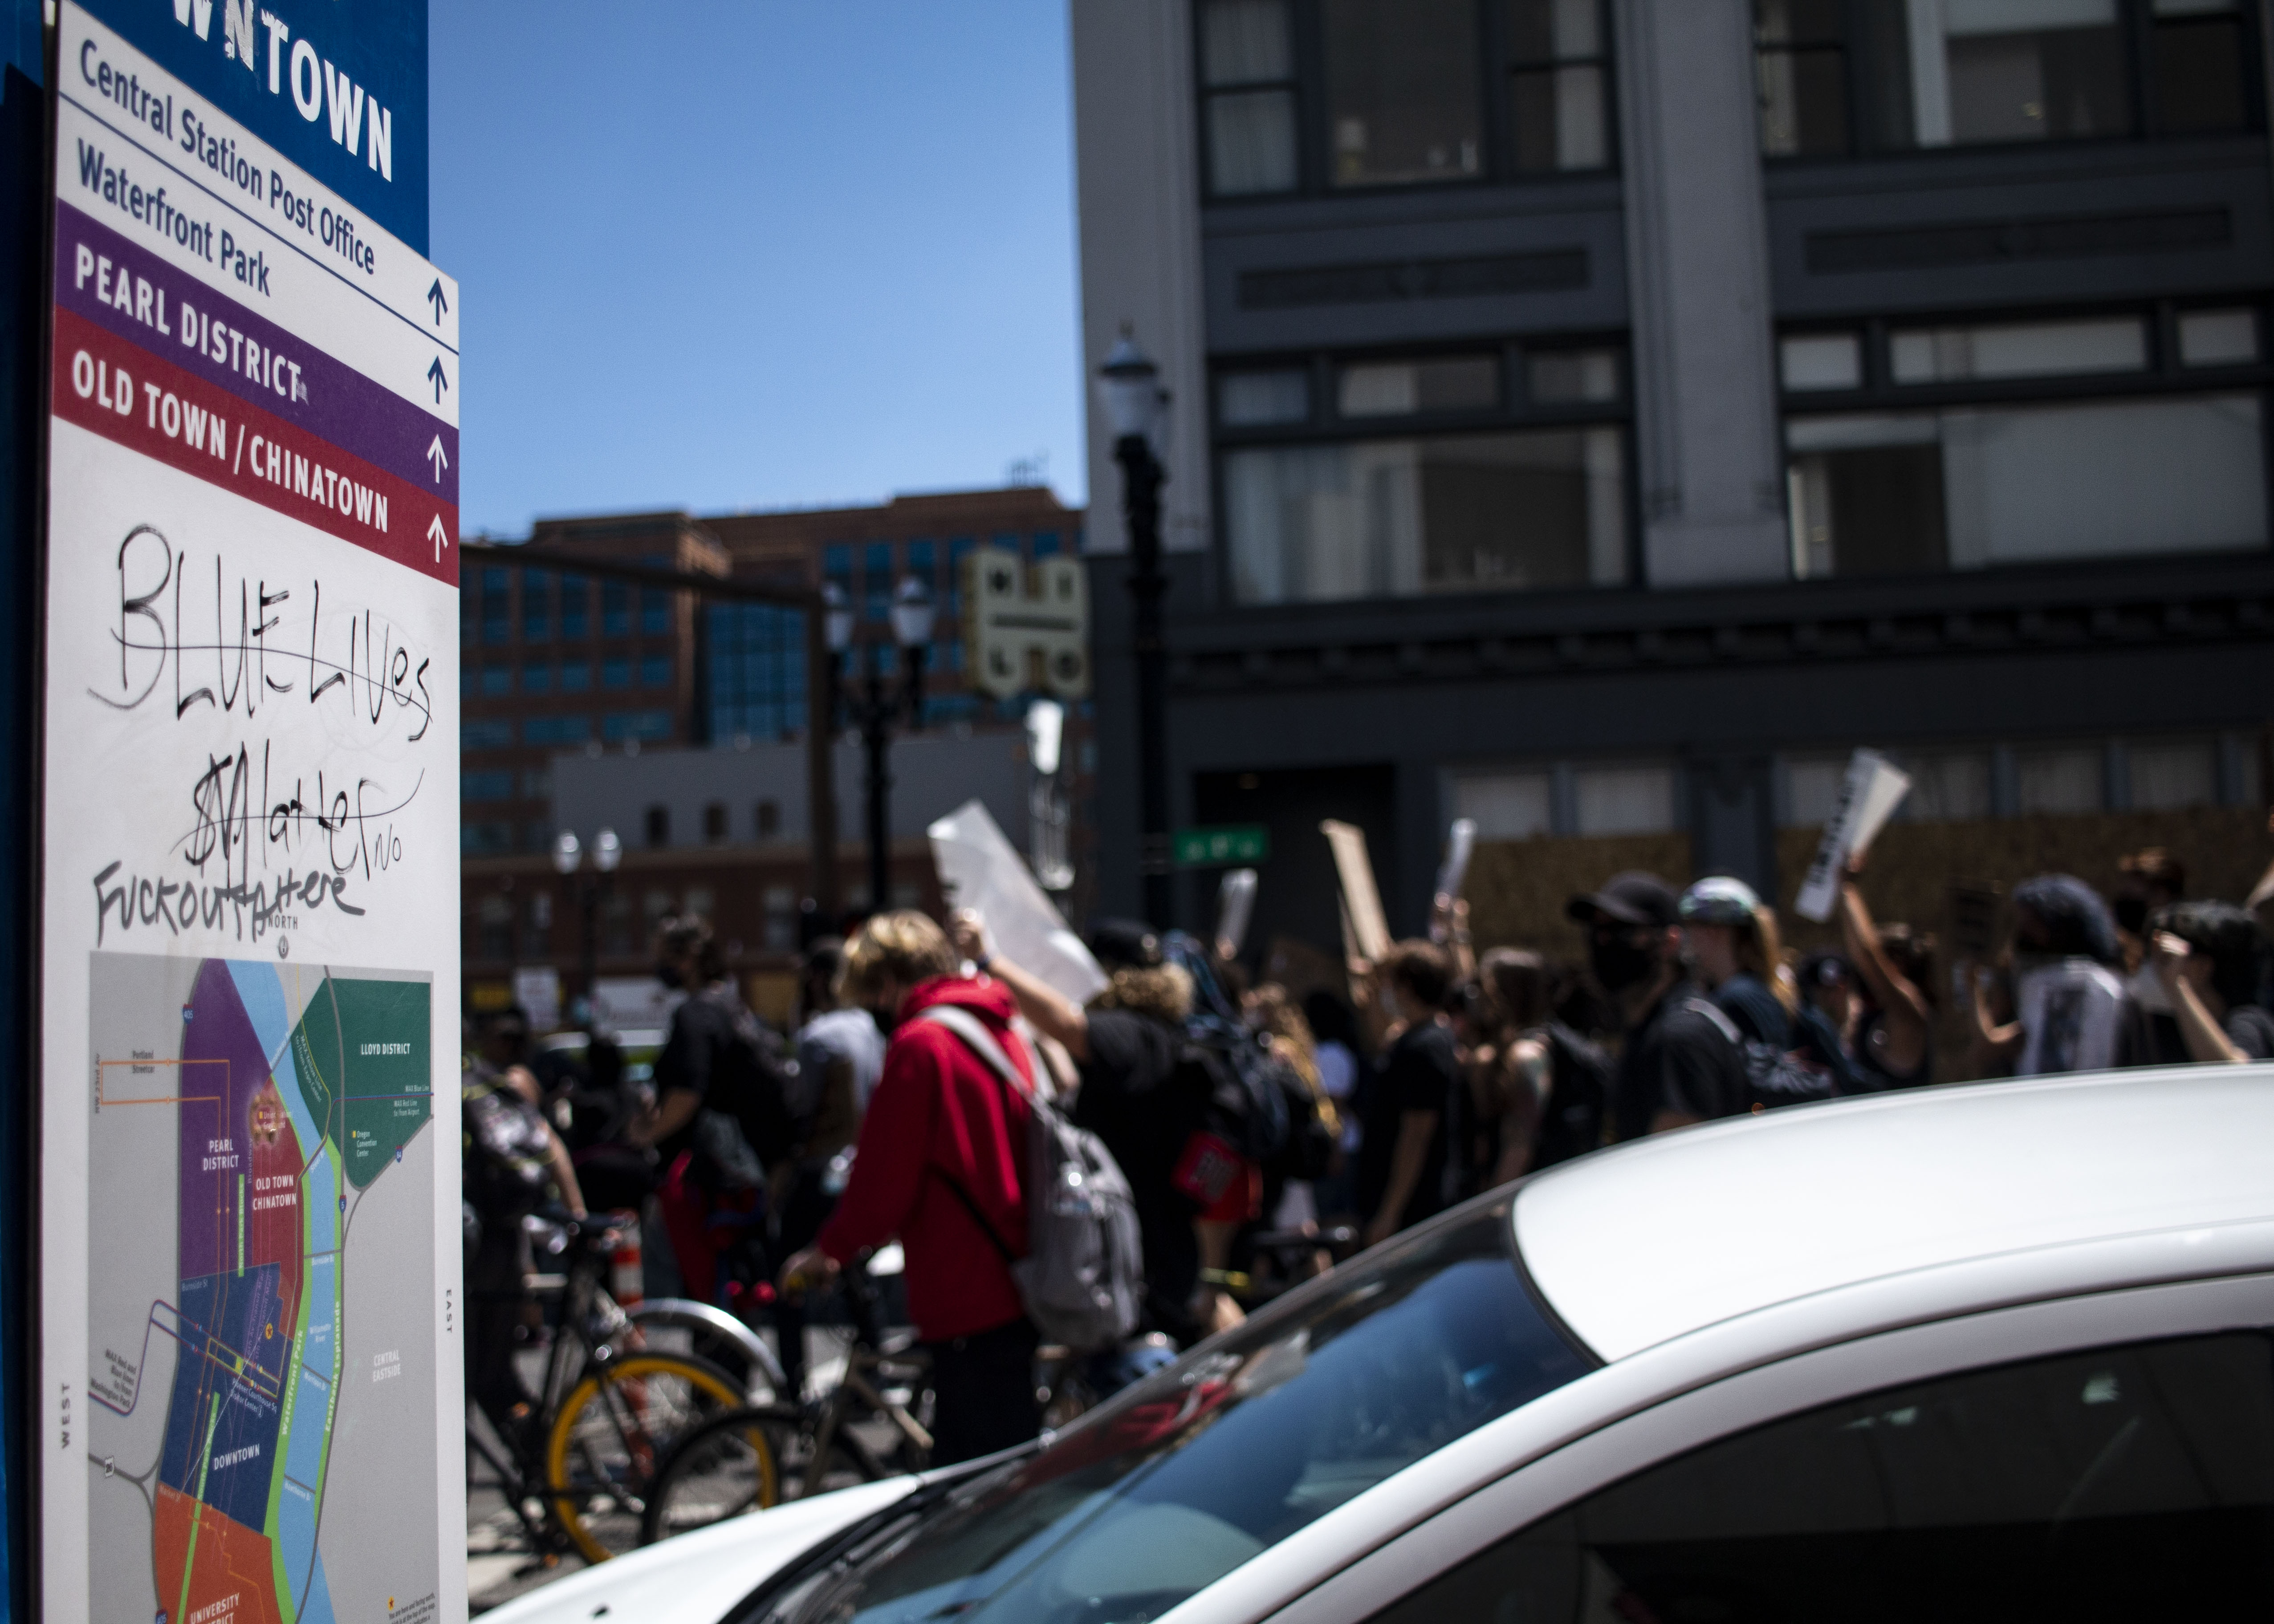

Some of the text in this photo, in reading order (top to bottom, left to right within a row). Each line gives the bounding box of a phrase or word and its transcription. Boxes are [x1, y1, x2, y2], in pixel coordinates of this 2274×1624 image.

[81, 39, 374, 275] Central Station Post Office
[77, 138, 271, 297] Waterfront Park
[75, 243, 302, 403] PEARL DISTRICT
[72, 350, 134, 416] OLD
[268, 914, 298, 930] NORTH
[183, 1009, 193, 1019] 405
[361, 1043, 411, 1055] LLOYD DISTRICT
[357, 1130, 370, 1139] Oregon
[209, 1139, 234, 1153] PEARL
[396, 1151, 402, 1159] 84
[203, 1155, 240, 1171] DISTRICT
[256, 1174, 294, 1191] OLD TOWN
[252, 1193, 297, 1211] CHINATOWN
[373, 1349, 400, 1367] CENTRAL
[373, 1364, 401, 1382] EASTSIDE
[282, 1330, 303, 1435] Waterfront Park
[245, 1398, 259, 1413] Center
[249, 1388, 272, 1409] Courthouse
[272, 1402, 277, 1414] Sq
[325, 1373, 339, 1432] Eastbank
[61, 1383, 70, 1449] WEST
[213, 1443, 260, 1470] DOWNTOWN
[190, 1592, 240, 1624] UNIVERSITY
